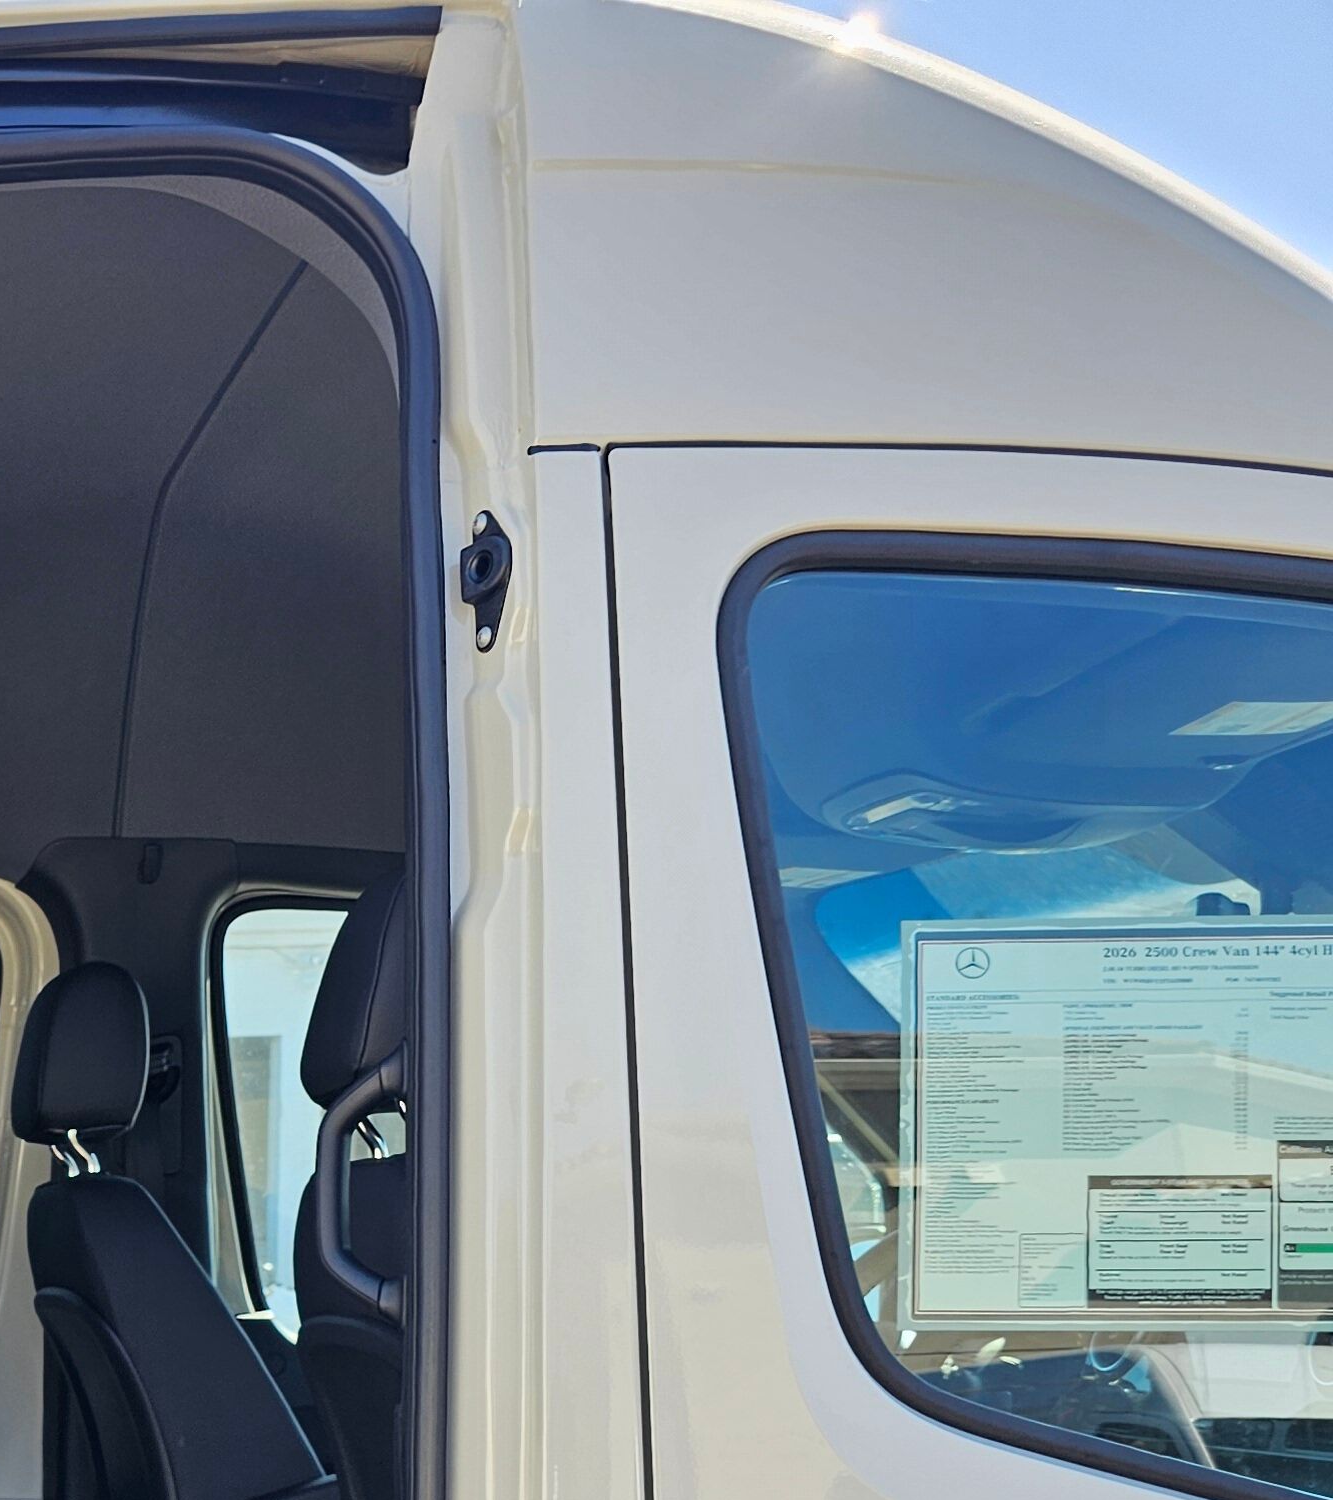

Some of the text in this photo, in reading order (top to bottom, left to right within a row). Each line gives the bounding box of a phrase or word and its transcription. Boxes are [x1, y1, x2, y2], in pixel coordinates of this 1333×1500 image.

[1103, 947, 1137, 958] 2026
[1145, 946, 1178, 957] 2500
[1183, 946, 1218, 957] Crew
[1222, 946, 1250, 957] Van
[1289, 944, 1318, 958] 4cyl
